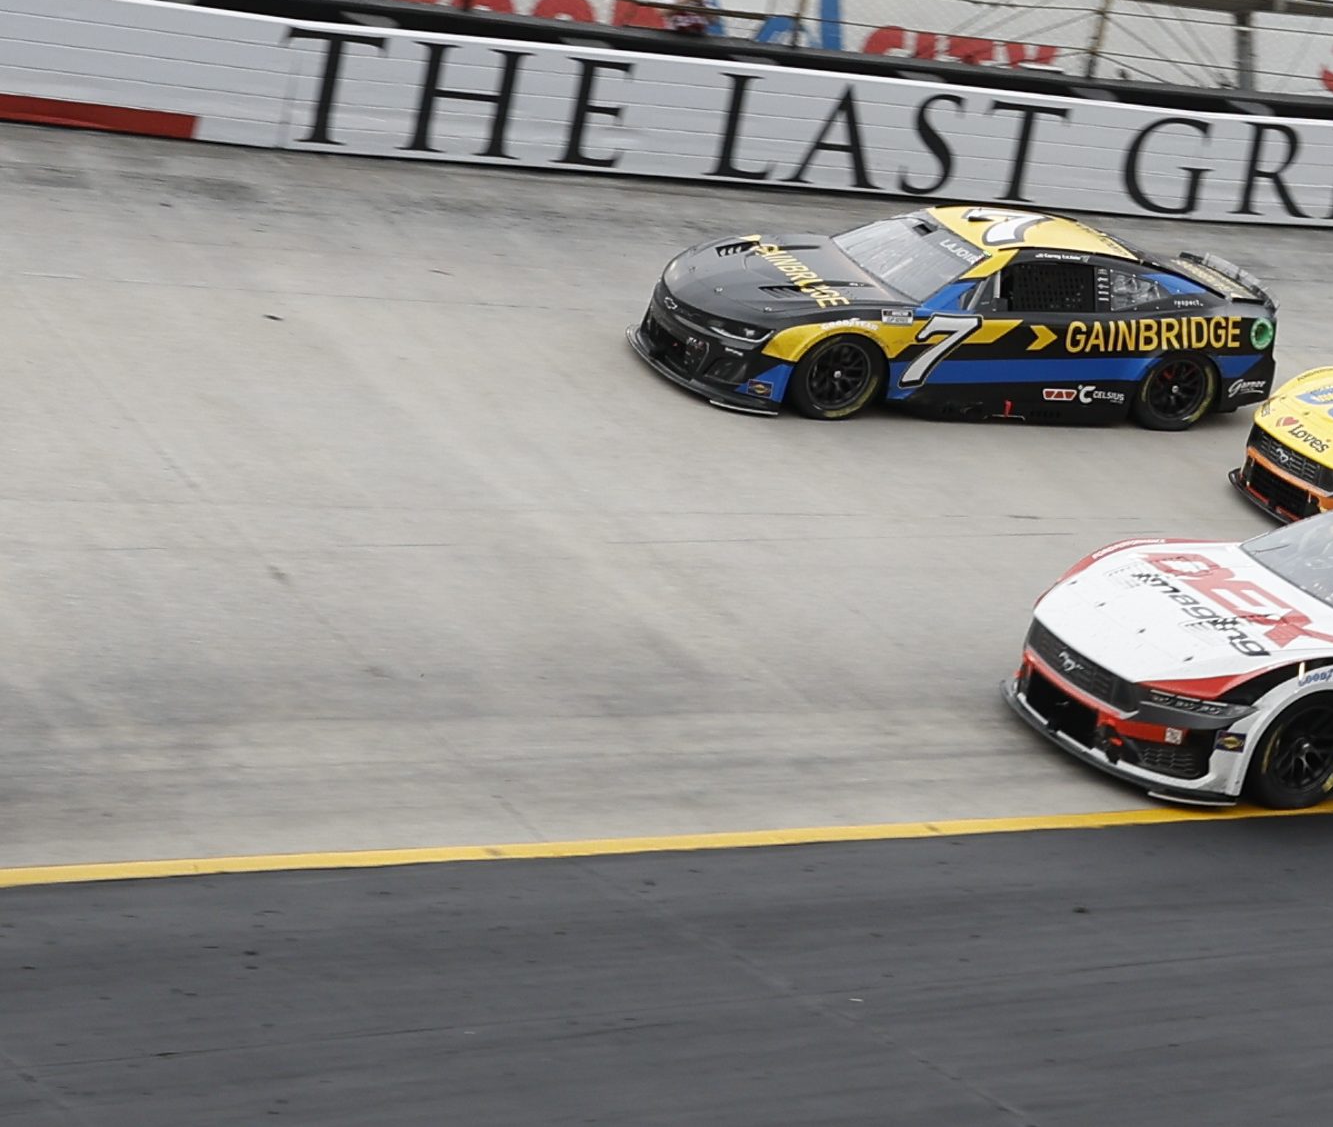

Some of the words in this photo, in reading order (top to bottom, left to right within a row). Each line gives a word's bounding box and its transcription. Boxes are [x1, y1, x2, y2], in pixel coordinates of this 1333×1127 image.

[284, 26, 639, 169] THE
[704, 72, 1071, 202] LAST
[966, 209, 1050, 246] 7
[901, 315, 983, 388] 7
[1066, 317, 1241, 352] GAINBRIDGE
